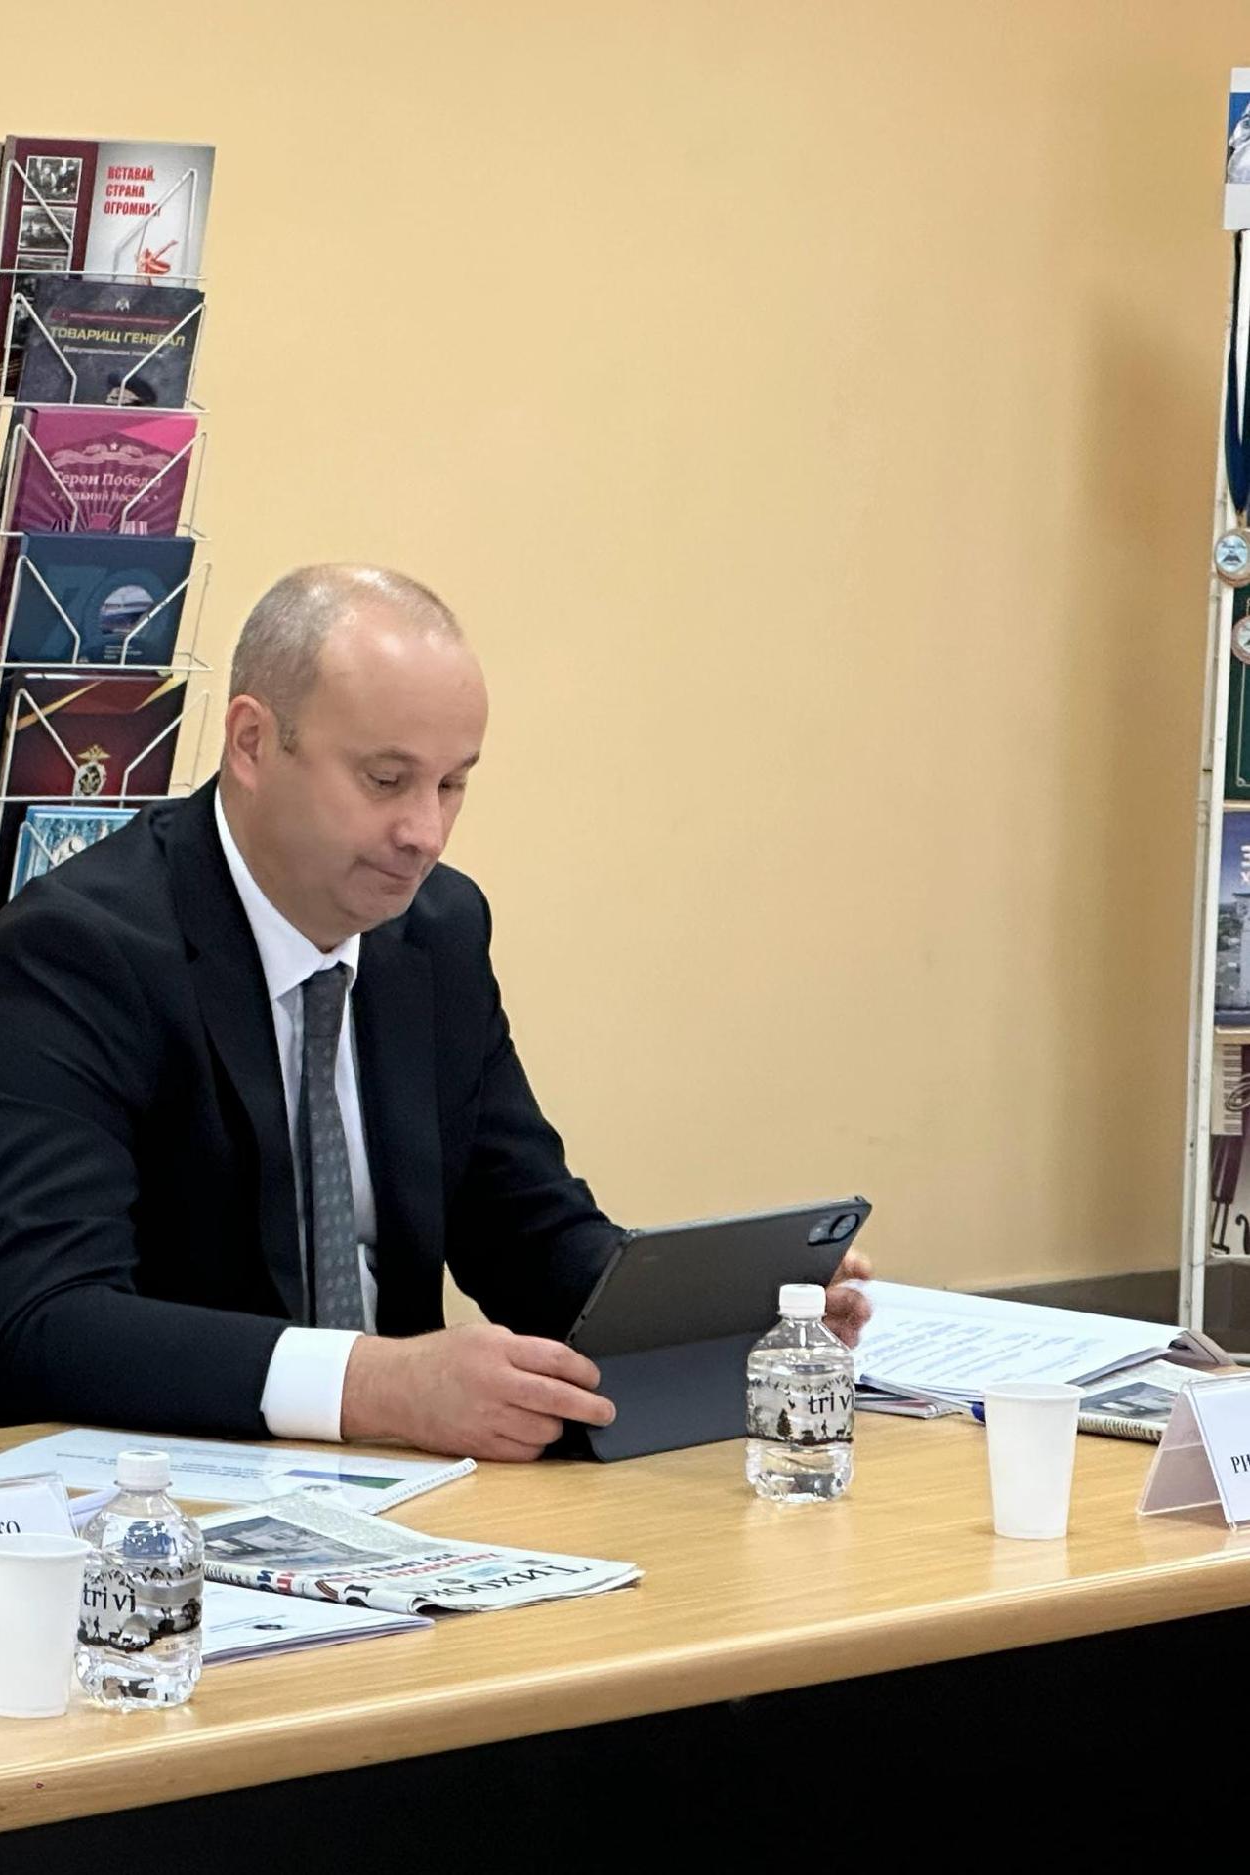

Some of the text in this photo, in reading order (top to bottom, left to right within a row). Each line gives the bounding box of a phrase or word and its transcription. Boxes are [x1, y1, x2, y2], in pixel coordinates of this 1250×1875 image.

[105, 184, 145, 198] СТРАНА
[50, 327, 121, 344] ТОВАРИЩ
[808, 1392, 834, 1415] tri
[83, 1582, 107, 1609] tri
